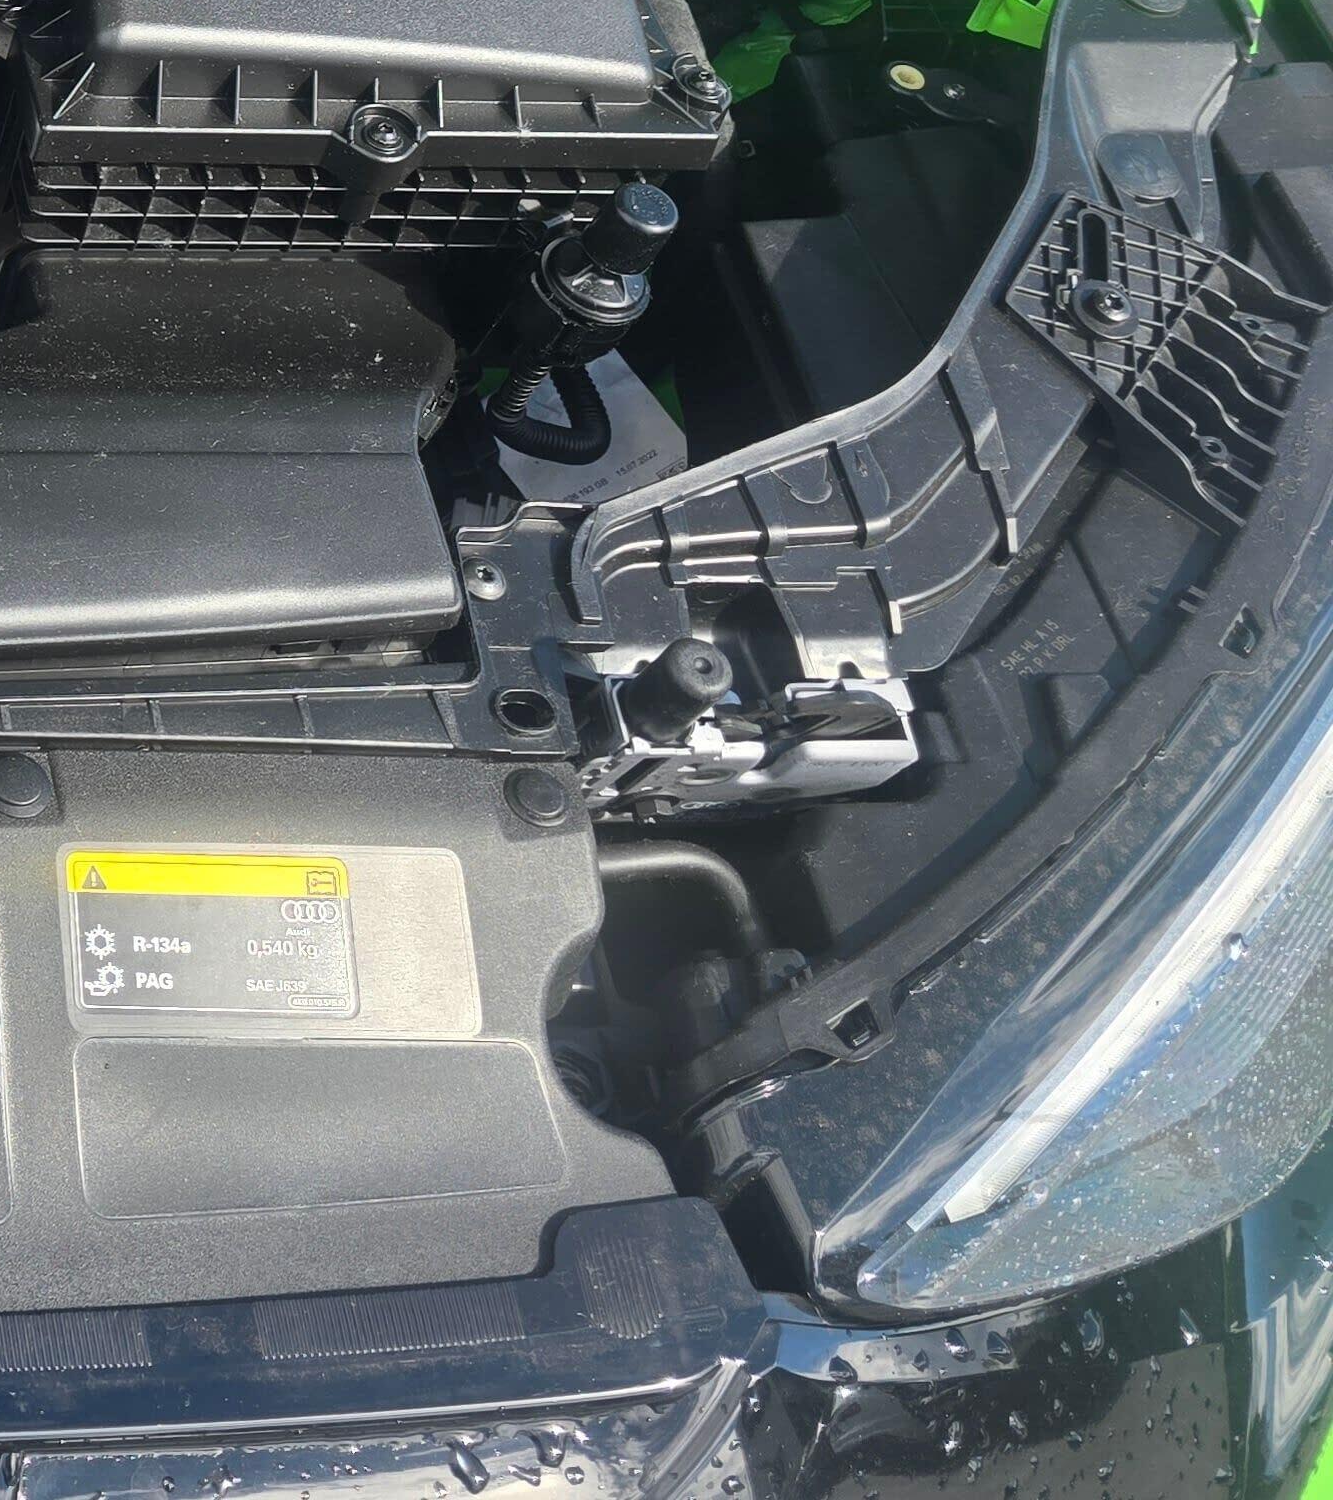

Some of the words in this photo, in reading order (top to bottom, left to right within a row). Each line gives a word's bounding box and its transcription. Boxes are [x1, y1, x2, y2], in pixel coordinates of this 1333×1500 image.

[1051, 633, 1076, 651] DRL
[1001, 651, 1025, 671] SAE
[285, 928, 311, 938] Audi
[133, 936, 191, 955] R-134a
[246, 940, 293, 957] 0,540
[298, 941, 319, 960] kg
[135, 973, 174, 991] PAG
[246, 979, 275, 992] SAE
